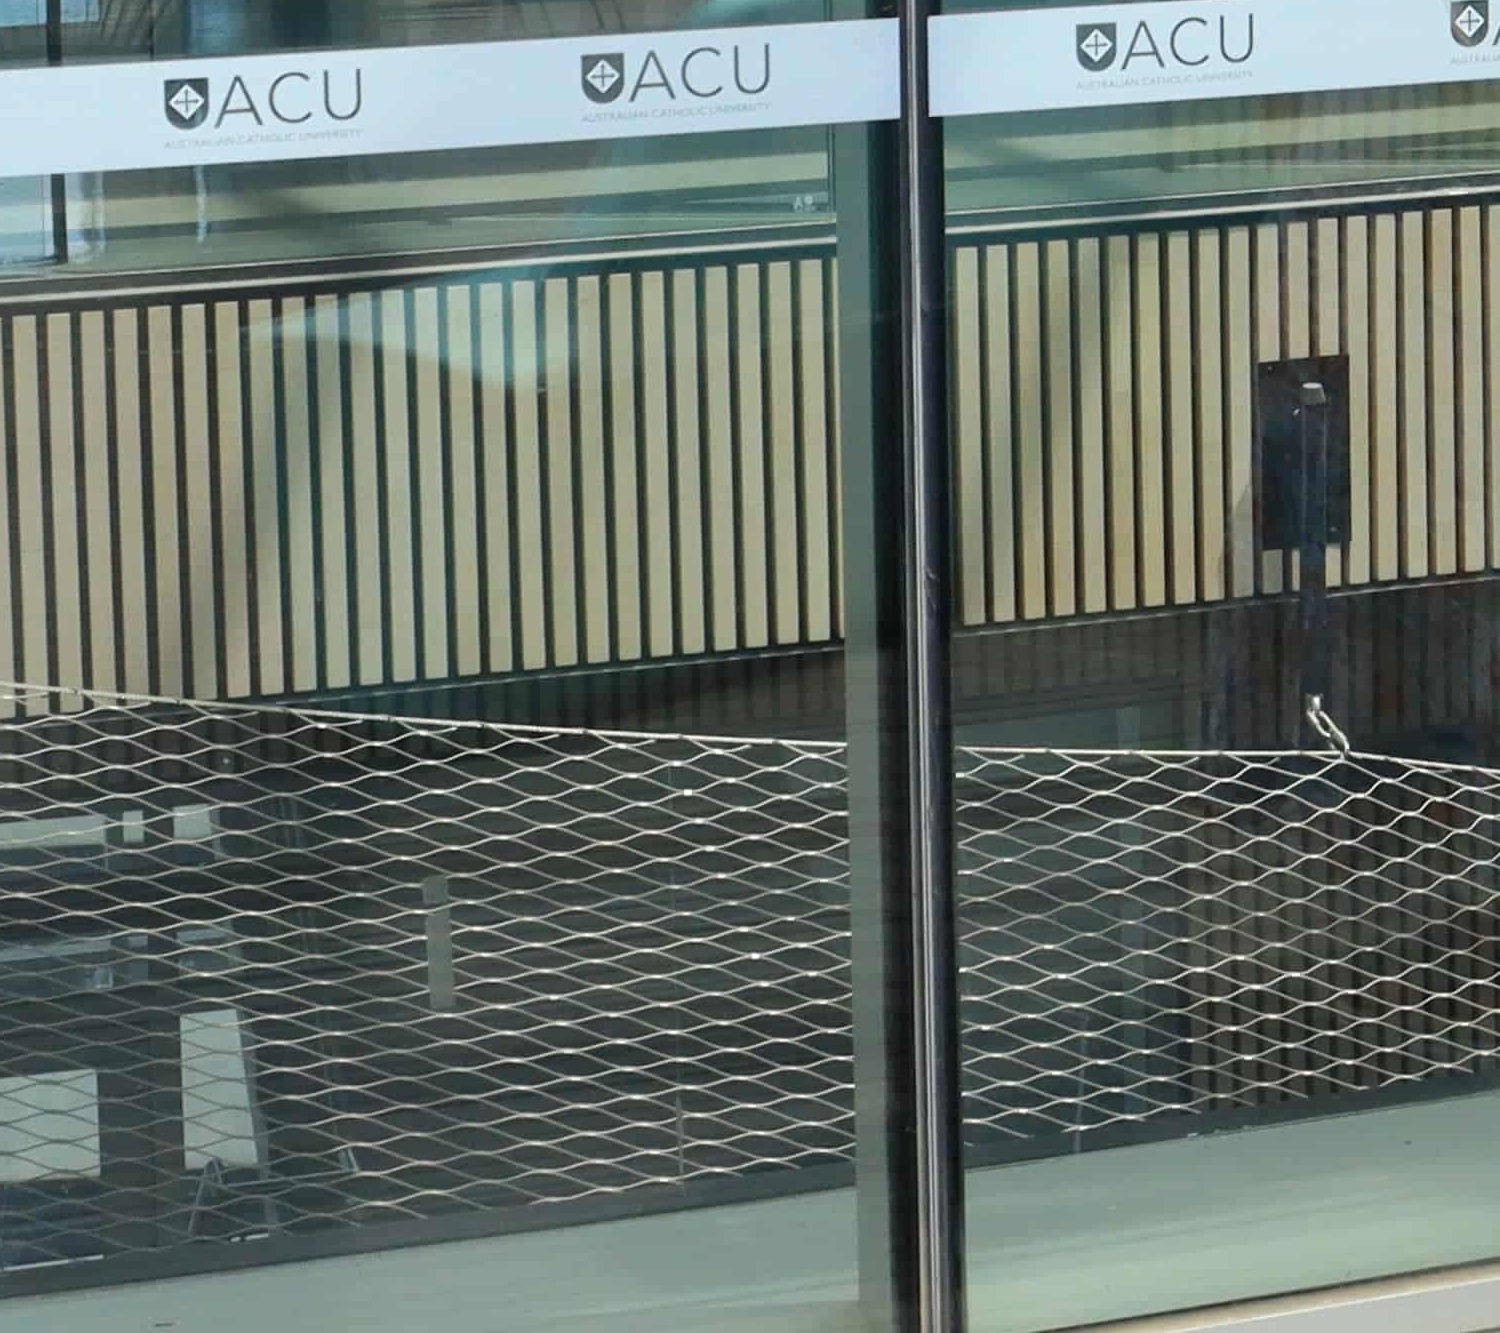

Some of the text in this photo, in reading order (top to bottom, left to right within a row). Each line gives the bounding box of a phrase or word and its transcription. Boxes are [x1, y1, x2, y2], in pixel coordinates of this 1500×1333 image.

[1120, 13, 1255, 71] ACU
[214, 68, 362, 129] ACU
[629, 43, 771, 102] ACU
